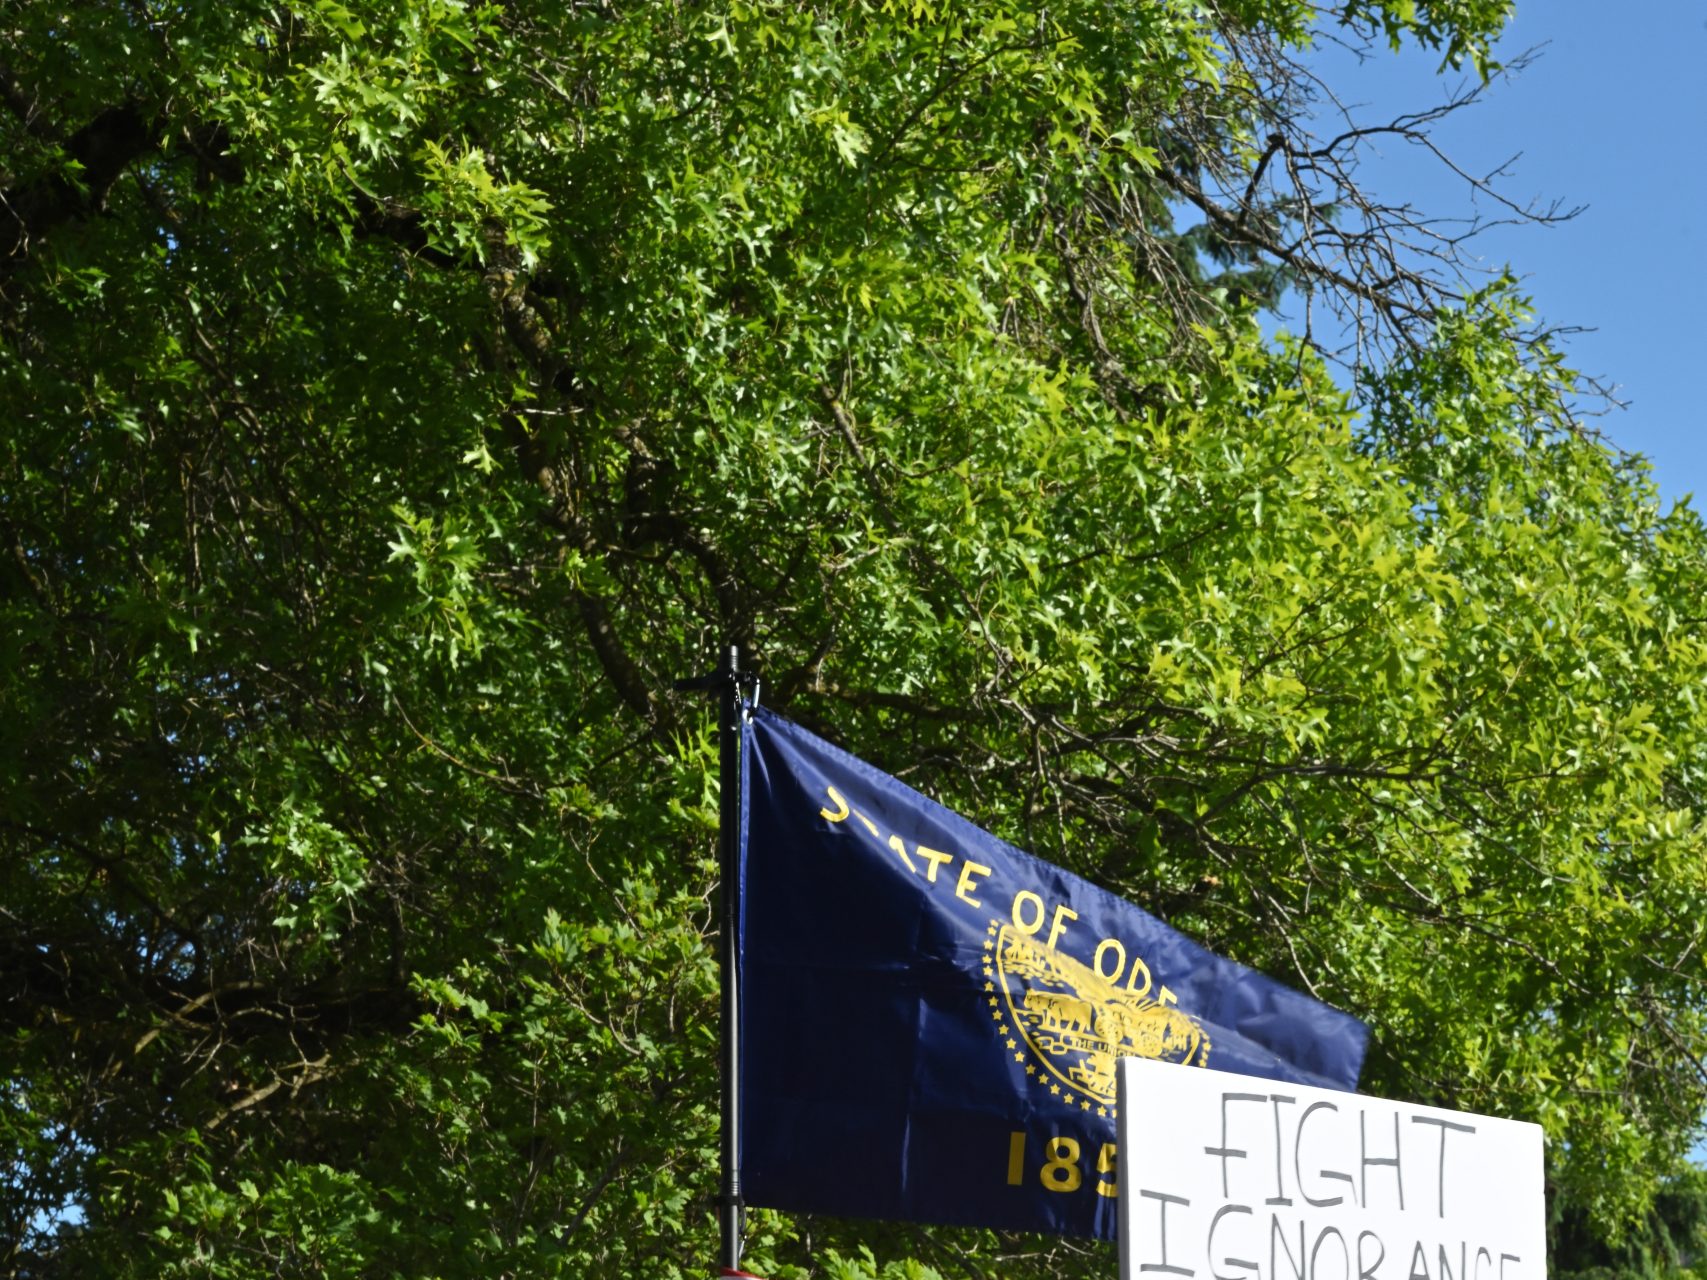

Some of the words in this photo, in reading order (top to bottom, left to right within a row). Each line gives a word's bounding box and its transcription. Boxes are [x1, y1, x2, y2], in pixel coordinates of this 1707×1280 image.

[1012, 890, 1078, 949] OF
[1070, 1038, 1095, 1049] THE
[1204, 1092, 1476, 1218] FIGHT
